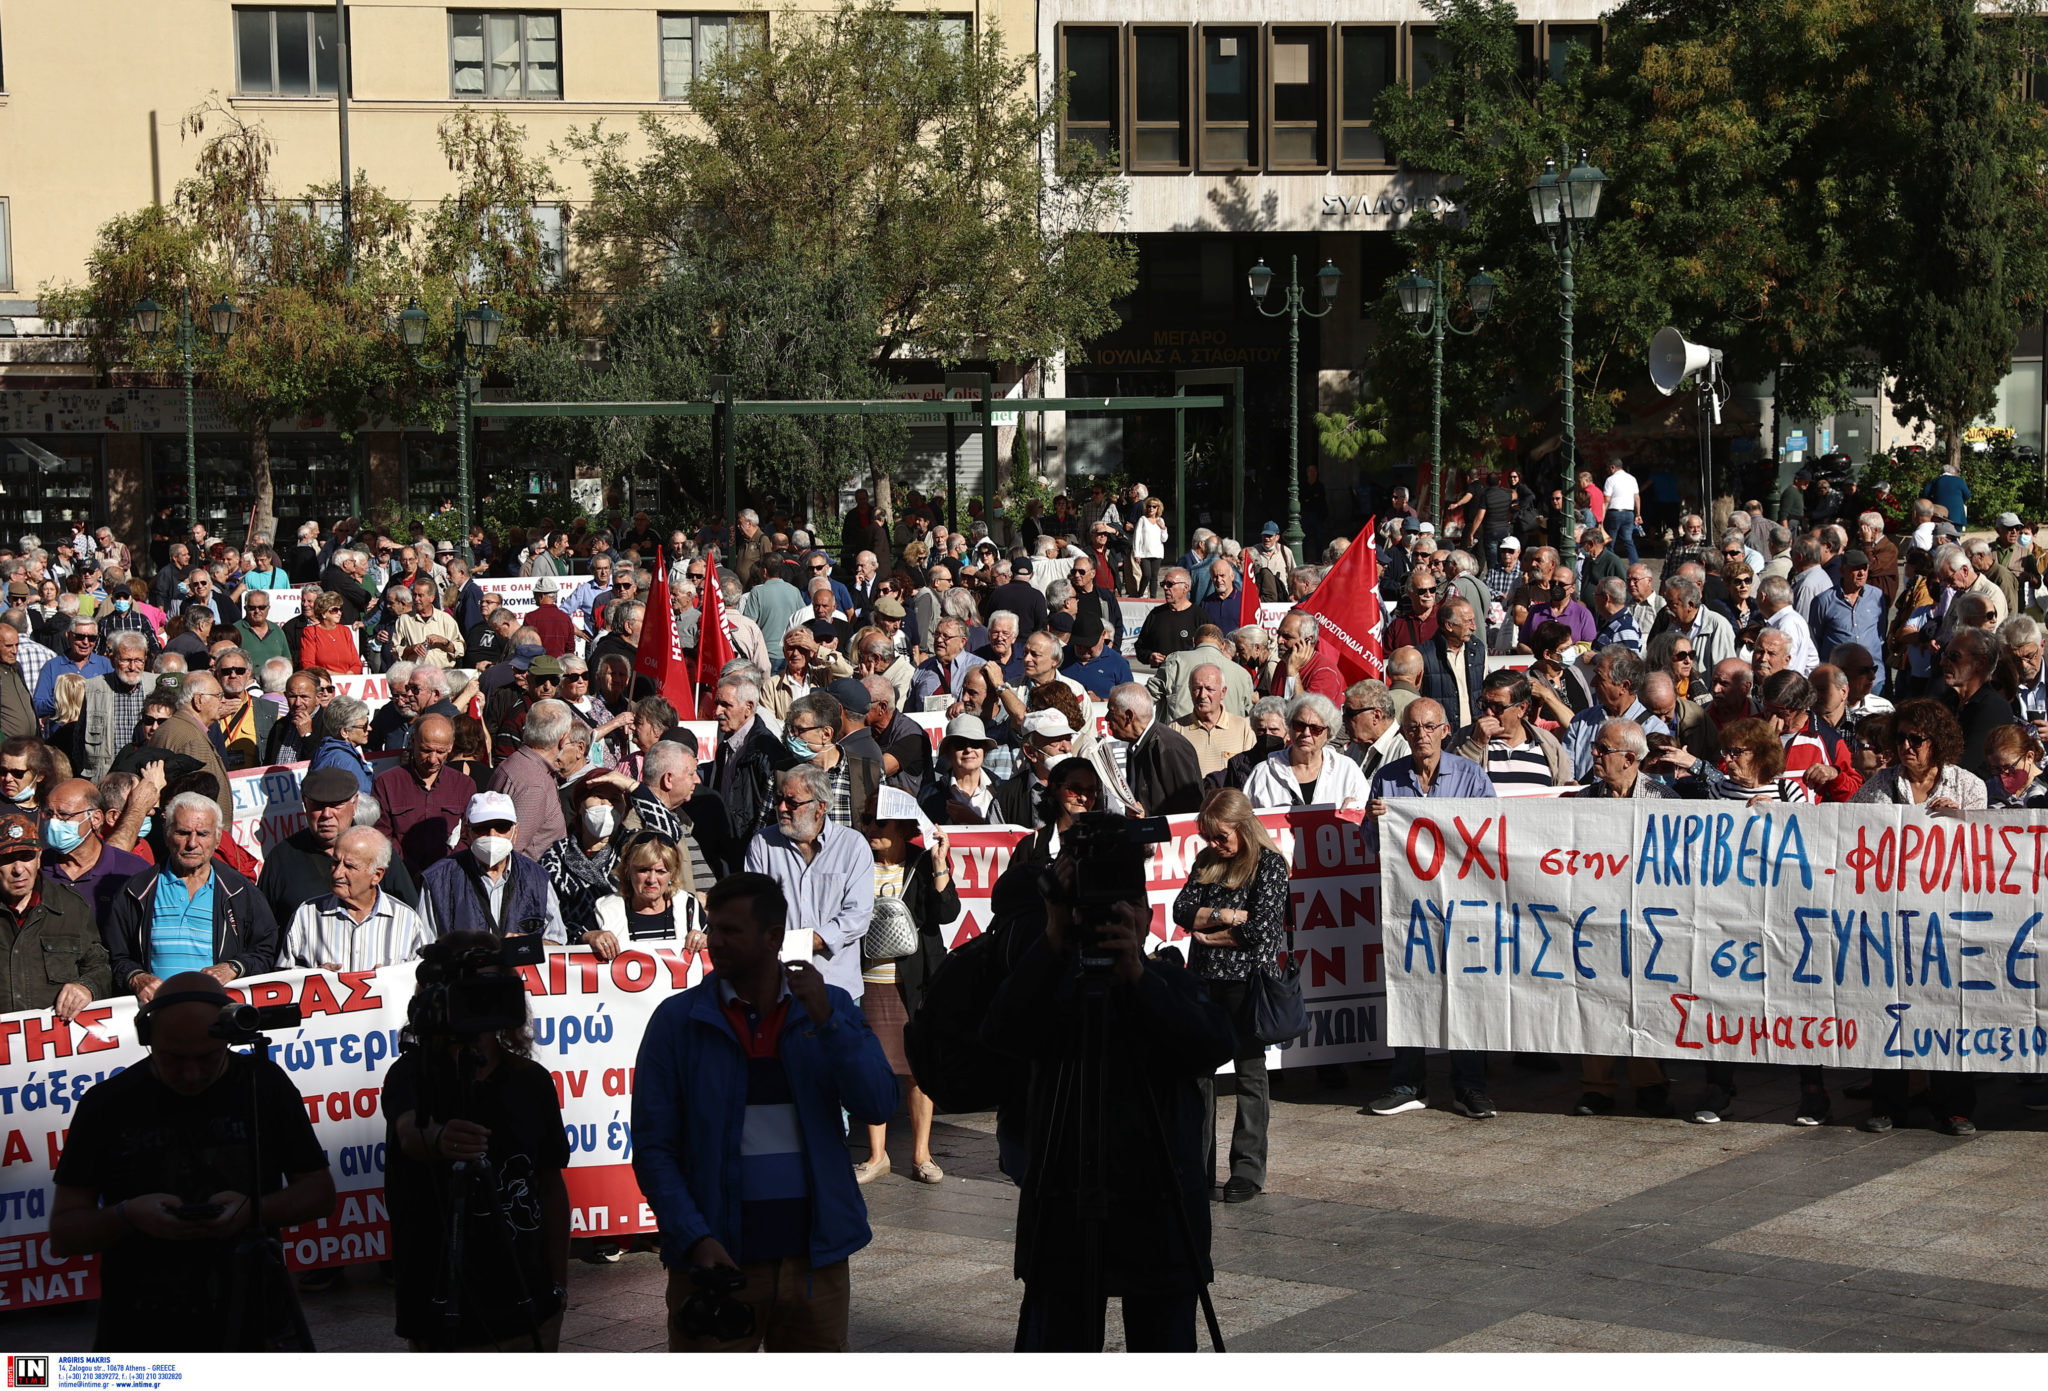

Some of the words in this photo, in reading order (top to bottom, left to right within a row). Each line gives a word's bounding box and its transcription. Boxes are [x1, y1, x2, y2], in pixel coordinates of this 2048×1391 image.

[1322, 194, 1458, 216] ΣΥΛΛΟΓΟΣ
[1153, 330, 1227, 346] ΜΕΓΑΡΟ
[1097, 349, 1165, 365] ΙΟΥΛΙΑΣ
[1191, 347, 1282, 363] ΣΤΑΘΑΤΟΥ
[492, 584, 507, 592] ΜΕ
[510, 584, 531, 592] ΟΛΗ
[1314, 612, 1363, 655] ΟΜΟΣΠΟΝΔΙΑ
[1405, 812, 1509, 882] ΟΧΙ
[1539, 847, 1629, 880] στην
[1635, 811, 1812, 890] ΑΚΡΙΒΕΙΑ
[1844, 823, 2048, 895] ΦΟΡΟΛΗΣΤ
[1404, 899, 1679, 984] ΑΥΞΗΣΕΙΣ
[1710, 939, 1768, 982] σε
[1791, 906, 2045, 990] ΣΥΝΤΑΞΕ
[1670, 993, 1858, 1056] Σωματειο
[21, 1271, 89, 1304] ΝΑΤ
